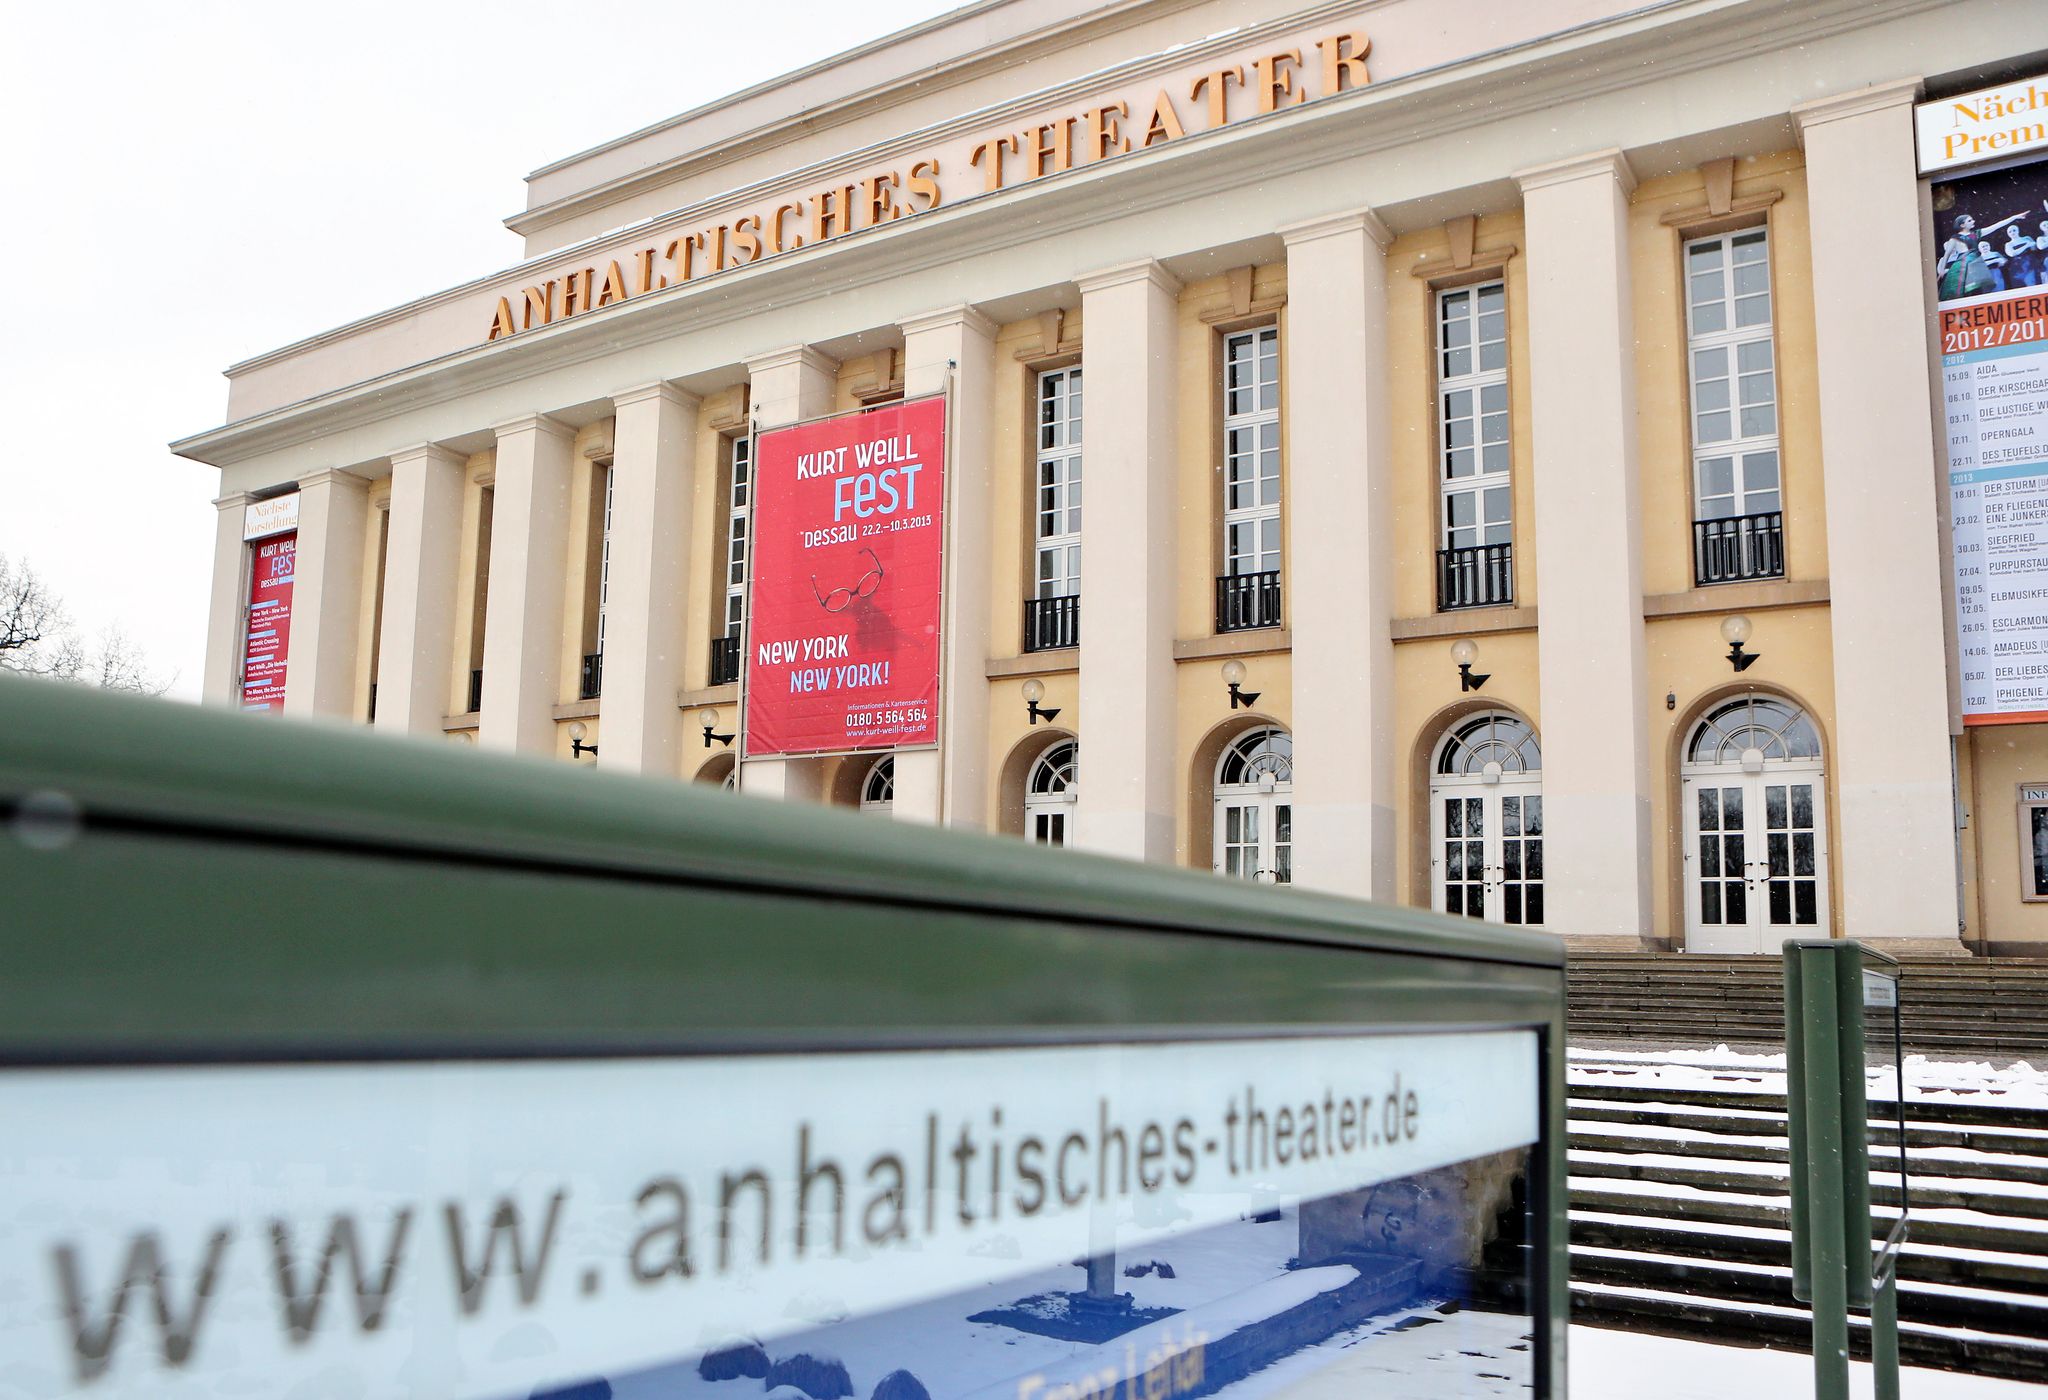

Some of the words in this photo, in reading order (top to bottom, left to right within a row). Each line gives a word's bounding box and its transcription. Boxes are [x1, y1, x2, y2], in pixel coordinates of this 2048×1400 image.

[487, 158, 942, 341] ANHALTISCHES
[969, 29, 1373, 192] THEATER
[1945, 354, 1966, 365] 2012
[1977, 364, 1998, 375] AIDA
[1978, 386, 1996, 397] DER
[1980, 407, 1995, 418] DIE
[1997, 401, 2034, 415] LUSTIGE
[1981, 427, 2034, 441] OPERNGALA
[1982, 450, 1999, 460] DES
[2003, 445, 2040, 458] TEUFELS
[797, 446, 848, 481] KURT
[1953, 473, 1974, 484] 2013
[834, 463, 923, 522] FeST
[1984, 483, 2002, 493] DER
[2005, 480, 2037, 491] STURM
[1986, 503, 2004, 514] DER
[1986, 514, 2007, 524] EINE
[2010, 509, 2048, 522] JUNKER
[804, 523, 858, 549] Dessau
[1987, 532, 2035, 546] SIEGFRIED
[260, 543, 278, 558] KURT
[1960, 597, 1972, 605] bis
[758, 639, 799, 666] NeW
[802, 634, 849, 662] YORK
[1994, 640, 2038, 652] AMADEUS
[789, 667, 831, 693] NeW
[836, 661, 890, 689] YORK!
[1995, 667, 2014, 677] DER
[1996, 687, 2043, 698] IPHIGENIE
[847, 702, 885, 711] Informationen
[891, 698, 928, 708] Kartenservice
[846, 711, 883, 727] 0180.5
[885, 709, 904, 723] 564
[907, 708, 928, 722] 564
[846, 723, 927, 737] www.kurt-weill-fest.de
[47, 1070, 1420, 1385] www.anhaltisches-theater.de
